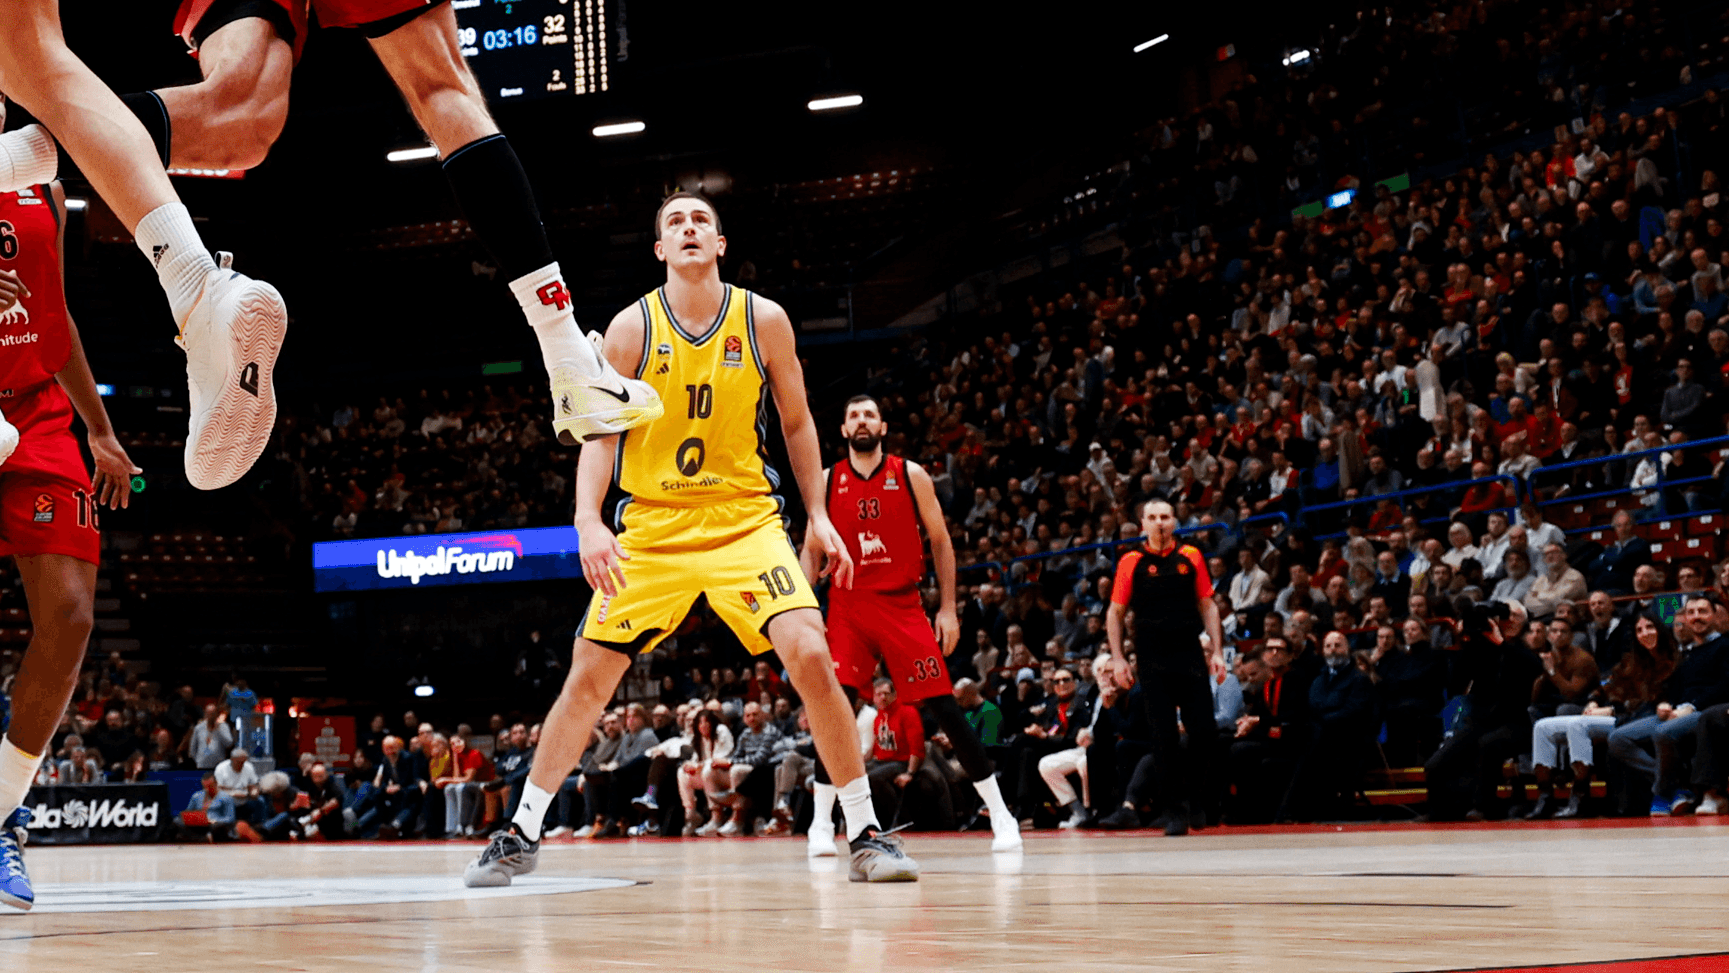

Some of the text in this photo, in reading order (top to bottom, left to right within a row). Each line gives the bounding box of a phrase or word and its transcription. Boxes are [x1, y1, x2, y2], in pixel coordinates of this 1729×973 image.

[483, 24, 538, 50] 03:16
[544, 14, 566, 34] 32
[552, 69, 561, 81] 2
[686, 383, 713, 419] 10
[856, 497, 881, 520] 33
[377, 546, 514, 585] UnipolForum
[758, 565, 796, 601] 10
[913, 656, 941, 682] 33
[88, 799, 159, 828] World
